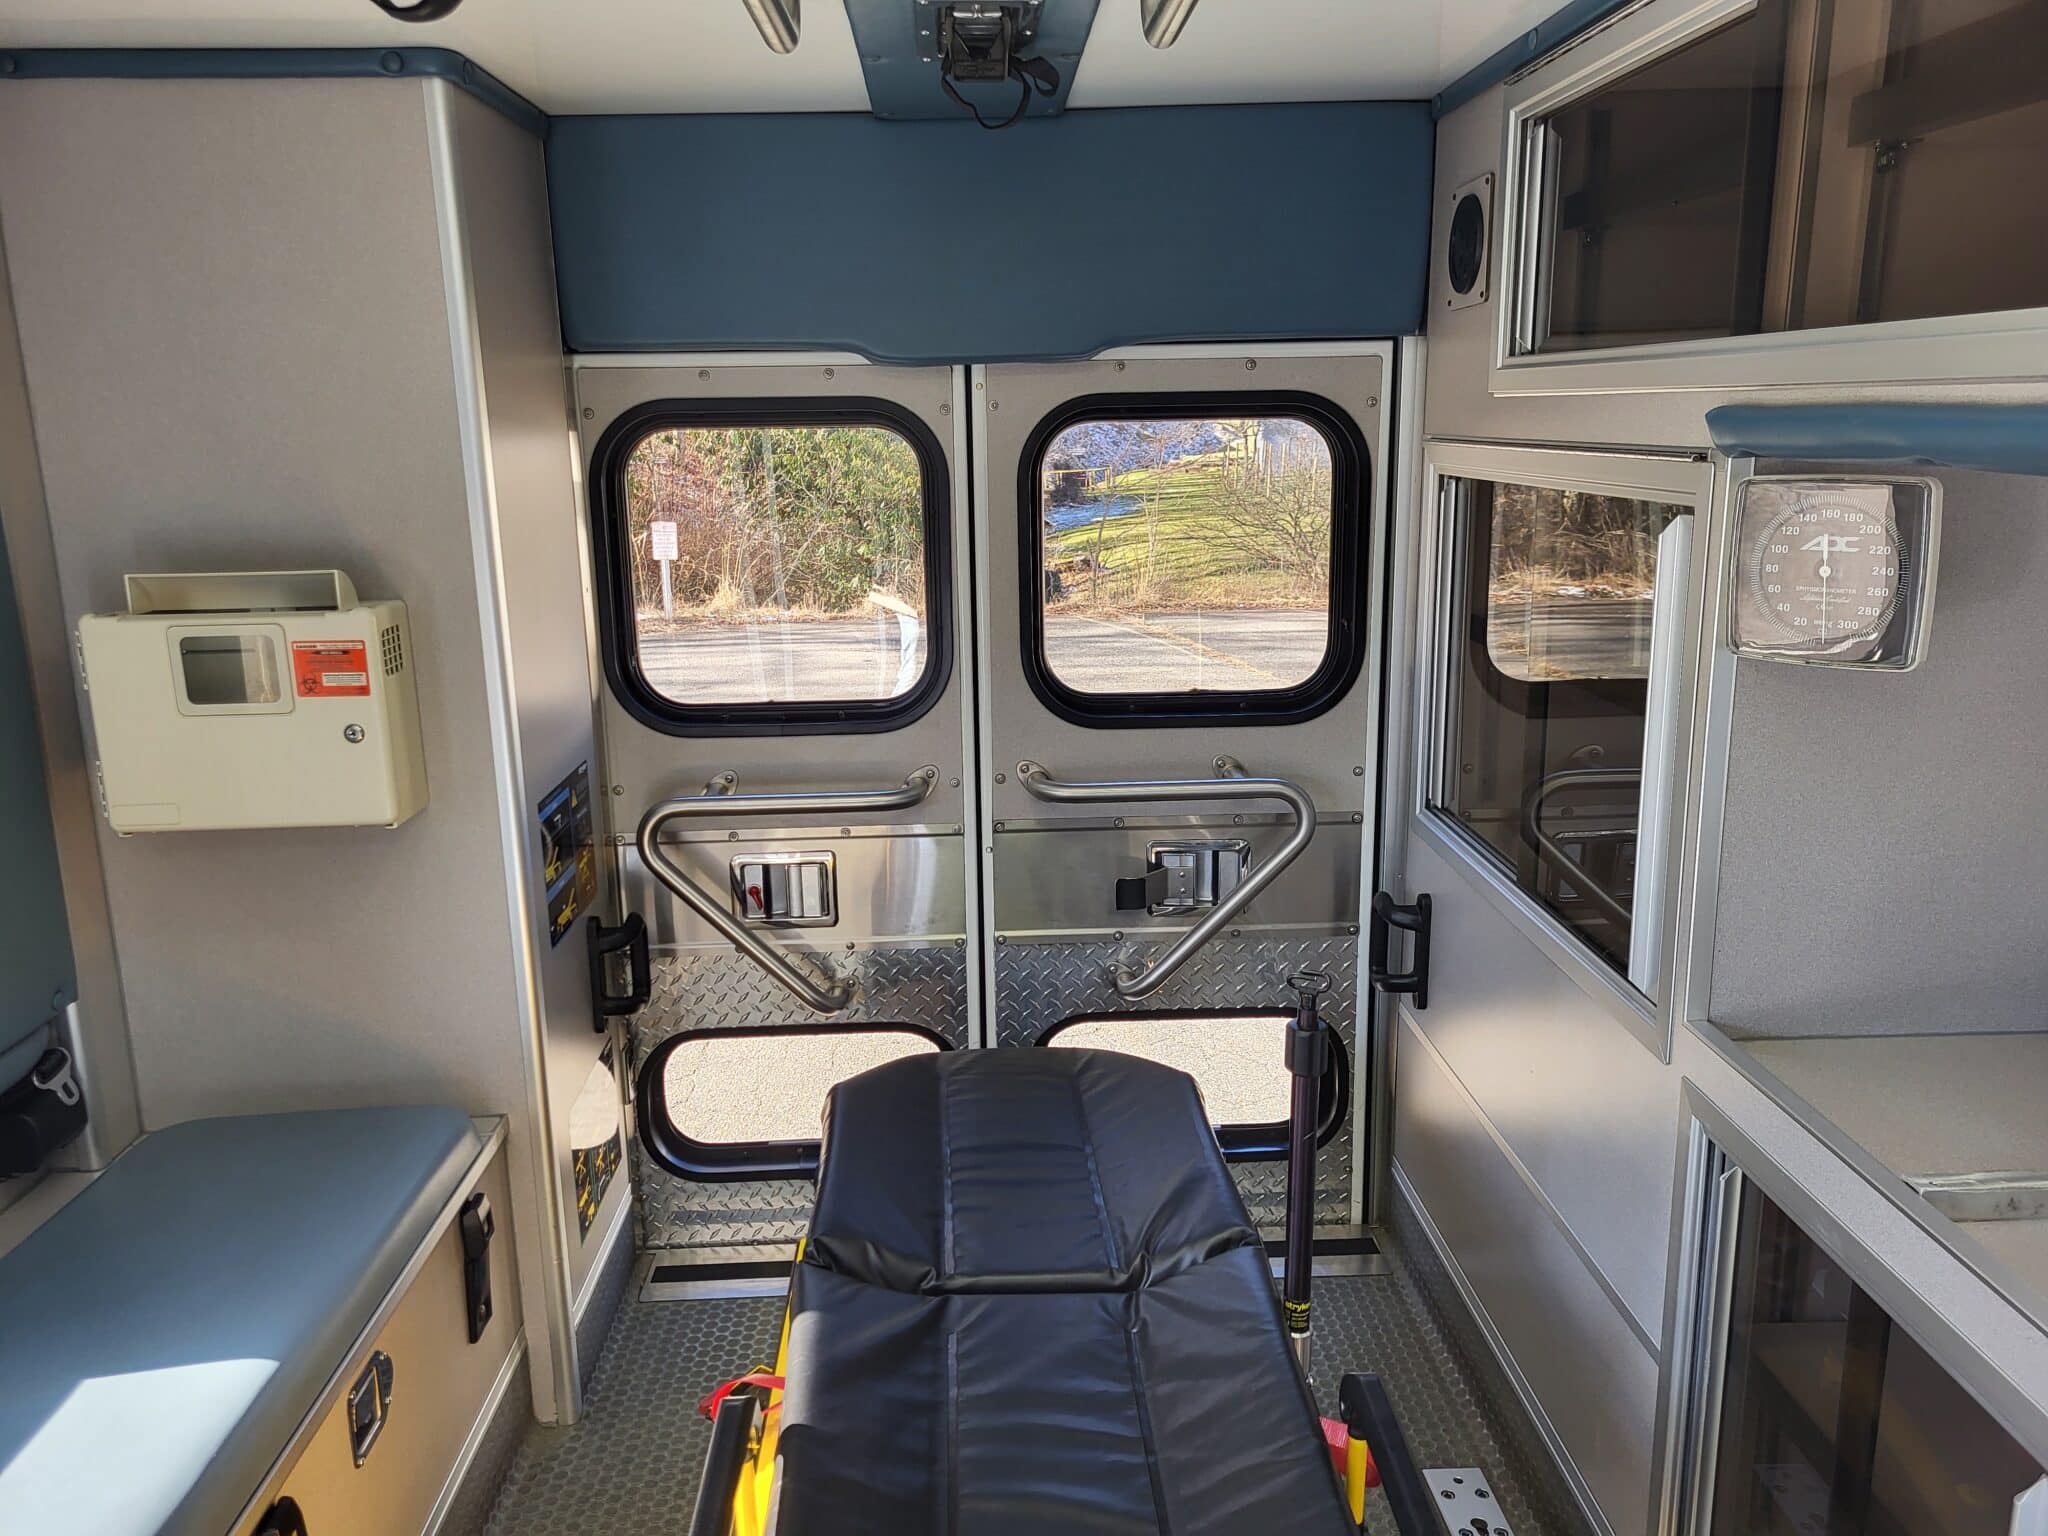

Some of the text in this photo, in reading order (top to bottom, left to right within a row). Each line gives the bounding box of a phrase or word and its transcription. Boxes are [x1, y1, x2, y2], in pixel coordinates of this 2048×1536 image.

[1799, 513, 1818, 522] 140
[1821, 509, 1840, 518] 160
[1844, 513, 1863, 522] 180
[1782, 526, 1799, 535] 120
[1859, 525, 1881, 534] 200
[1771, 545, 1788, 553] 100
[1869, 546, 1891, 555] 220
[1766, 564, 1778, 573] 80
[1871, 567, 1894, 576] 240
[1768, 585, 1781, 593] 60
[1867, 588, 1889, 597] 260
[1777, 604, 1790, 612] 40
[1857, 607, 1880, 616] 280
[1794, 617, 1807, 626] 20
[1837, 620, 1858, 629] 300
